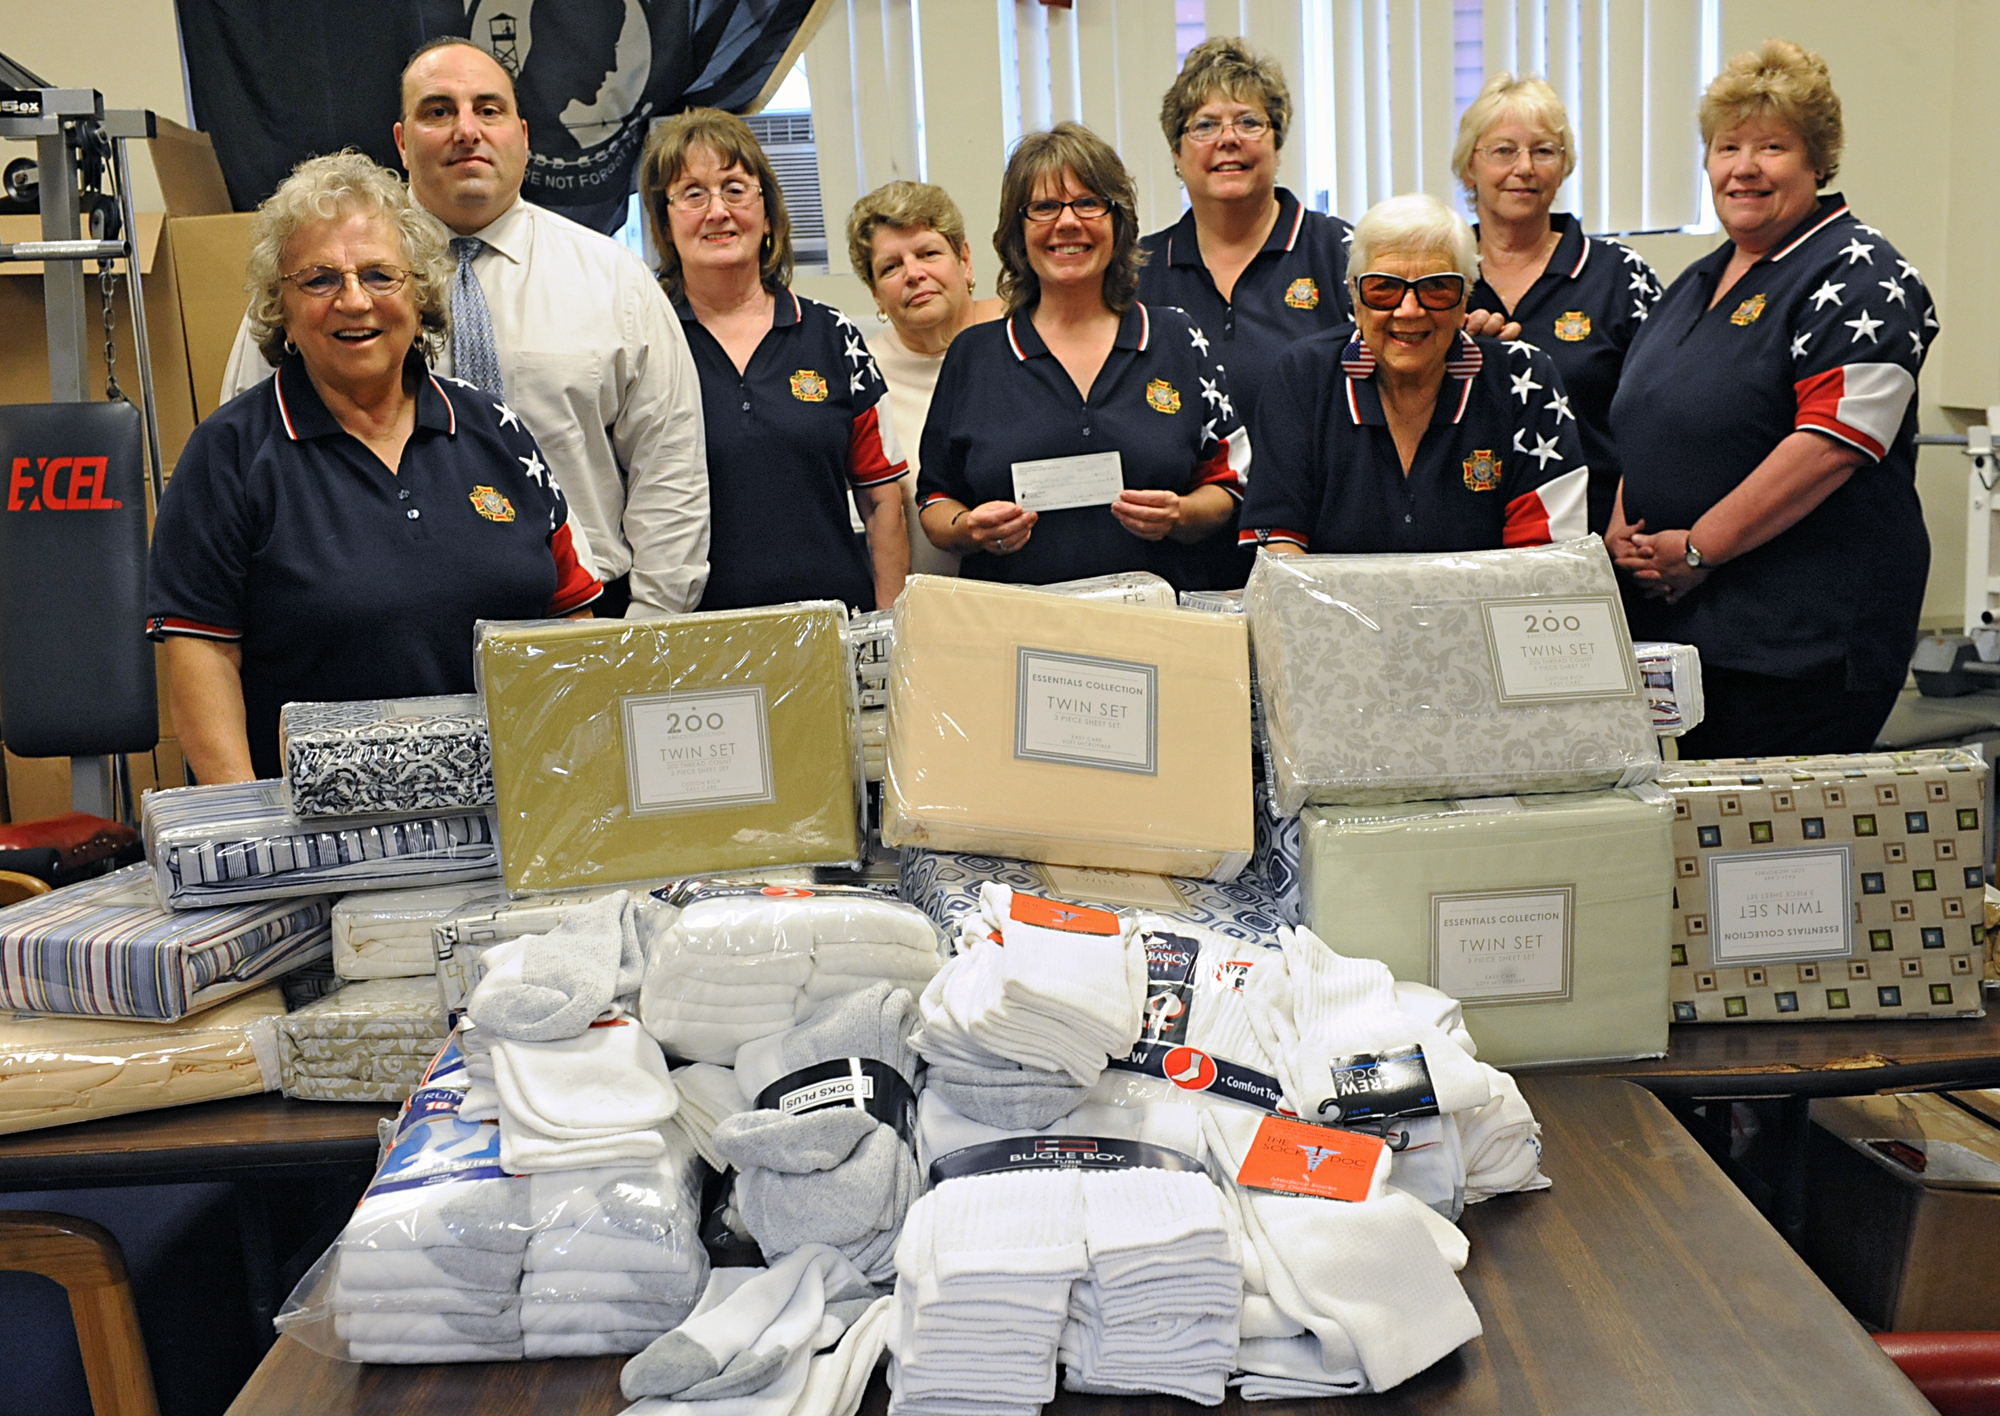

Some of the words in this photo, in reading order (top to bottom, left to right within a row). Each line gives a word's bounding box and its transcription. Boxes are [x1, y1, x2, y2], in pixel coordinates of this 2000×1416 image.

[0, 100, 40, 114] 5ex
[523, 168, 541, 186] RE
[545, 174, 574, 190] NOT
[579, 137, 638, 188] FORGOTT
[1524, 614, 1581, 633] 200
[1520, 645, 1563, 658] TWIN
[1569, 643, 1595, 655] SET
[1032, 674, 1083, 688] ESSENTIALS
[1085, 681, 1143, 695] COLLECTION
[1047, 696, 1092, 714] TWIN
[1100, 703, 1128, 719] SET
[666, 712, 724, 734] 200
[1061, 716, 1082, 724] PIECE
[1085, 719, 1106, 727] SHEET
[1108, 721, 1120, 729] SET
[660, 745, 702, 762] TWIN
[710, 742, 736, 757] SET
[697, 889, 745, 899] Crew
[1786, 890, 1808, 898] PIECE
[1739, 904, 1768, 919] SET
[1777, 900, 1823, 916] TWIN
[1444, 916, 1496, 927] ESSENTIALS
[1499, 912, 1559, 924] COLLECTION
[1724, 928, 1784, 940] COLLECTION
[1787, 925, 1839, 937] ESSENTIALS
[1145, 943, 1172, 951] DAN
[1459, 937, 1505, 953] TWIN
[1514, 934, 1543, 950] SET
[1149, 952, 1190, 966] BASICS
[819, 1083, 864, 1099] OCKS
[1226, 1075, 1265, 1097] Comfort
[1340, 1076, 1394, 1096] CREW
[425, 1101, 452, 1111] 10
[786, 1089, 816, 1109] PLUS
[1266, 1135, 1291, 1147] THE
[1010, 1152, 1077, 1162] BUGLE
[1083, 1152, 1125, 1162] BOY
[1263, 1142, 1303, 1157] SOCK
[1330, 1155, 1367, 1168] DOC
[1270, 1176, 1310, 1187] Medical
[1311, 1181, 1338, 1191] Socks
[1288, 1184, 1332, 1195] Diabetics
[1273, 1189, 1297, 1197] Crew
